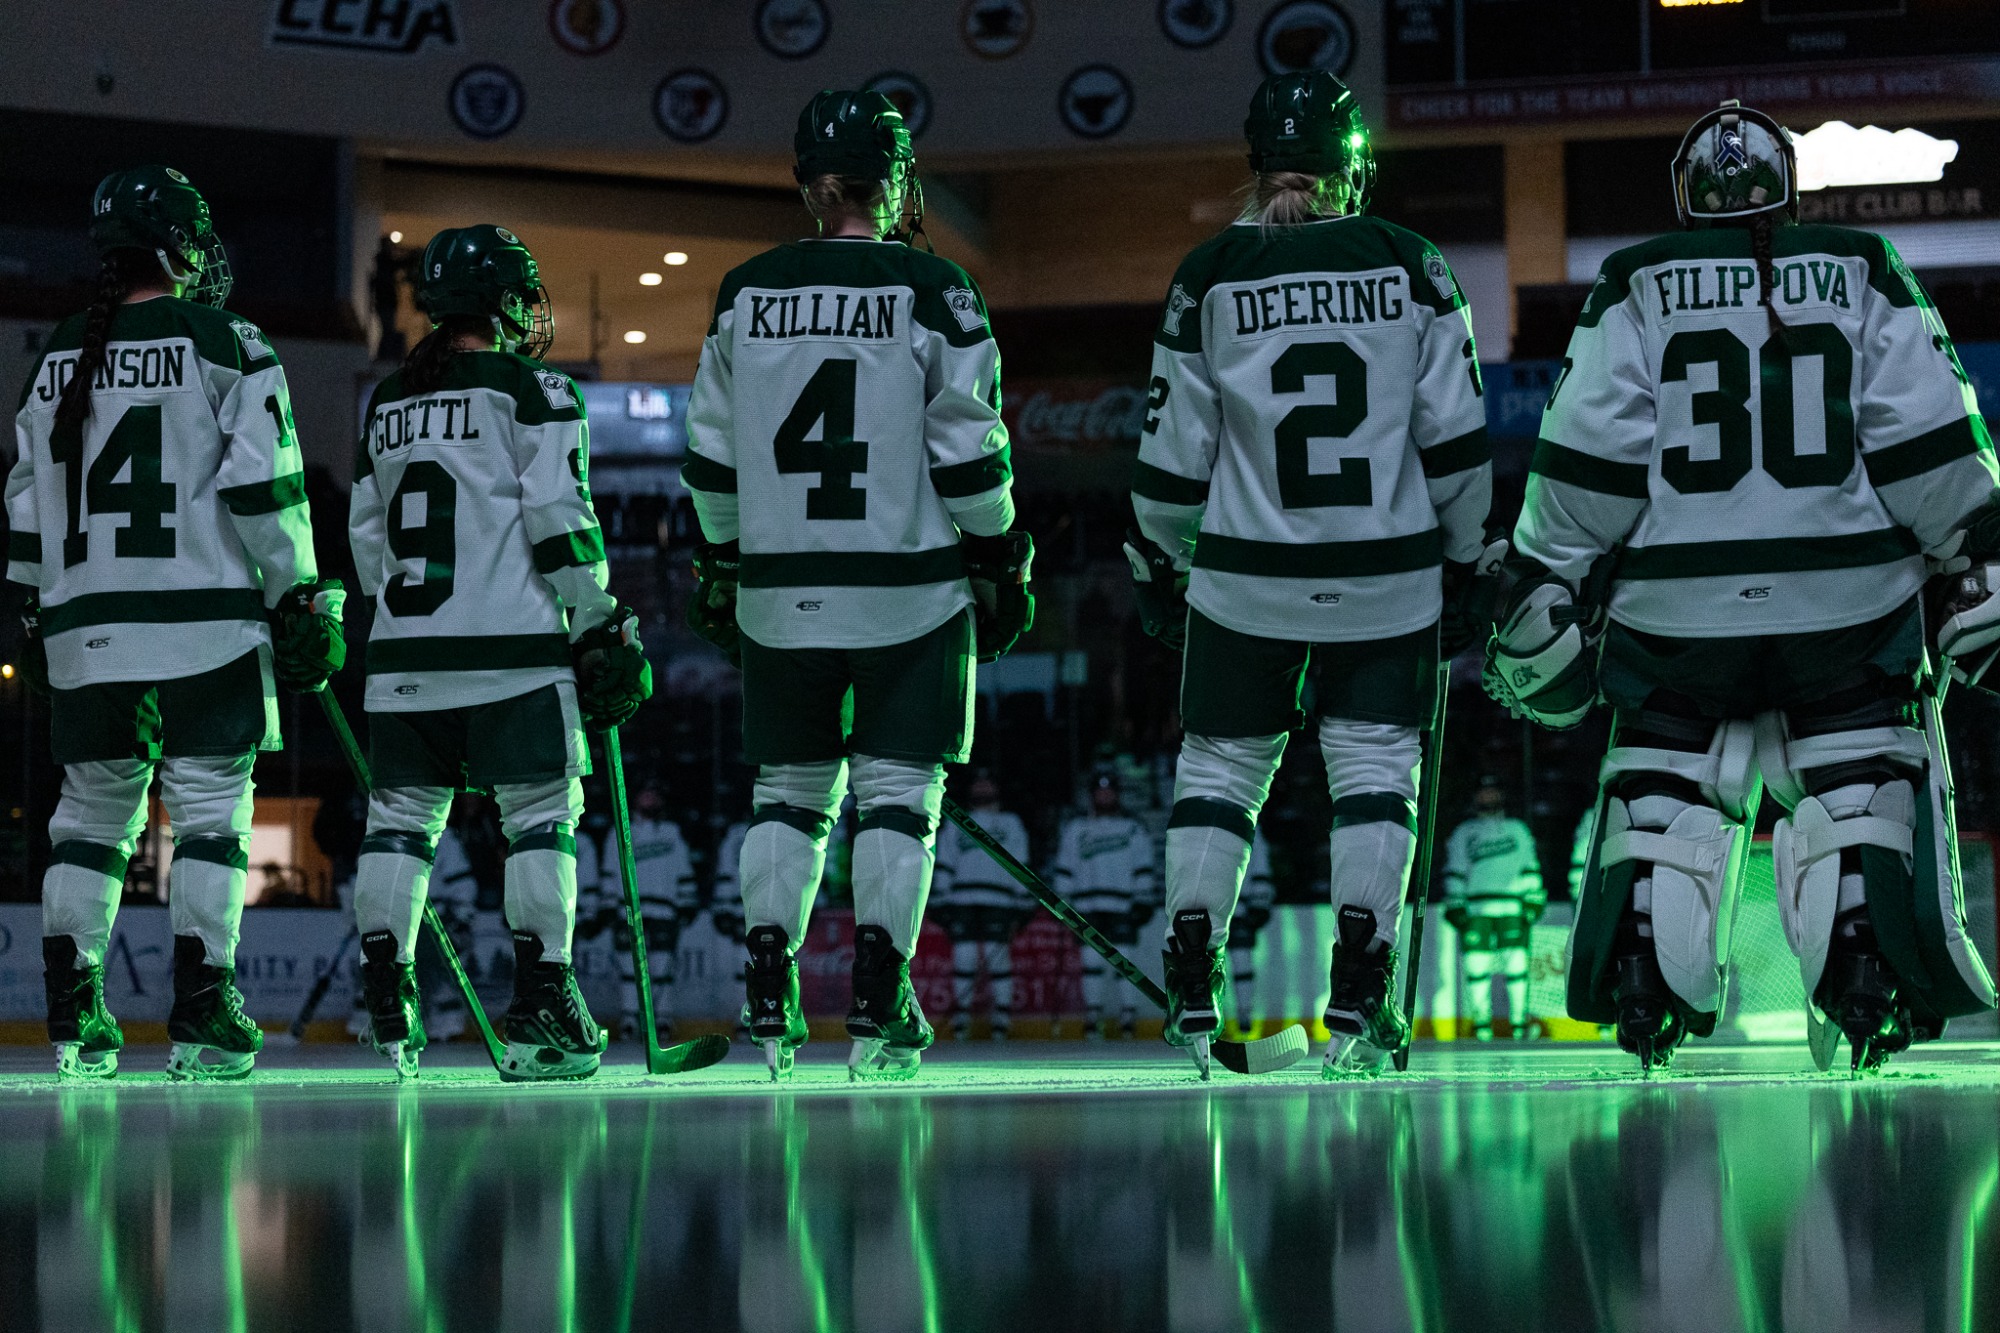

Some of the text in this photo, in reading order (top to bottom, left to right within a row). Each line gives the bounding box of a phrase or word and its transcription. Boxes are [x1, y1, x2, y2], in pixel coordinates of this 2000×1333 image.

[825, 122, 835, 137] 4
[1284, 118, 1295, 134] 2
[100, 198, 111, 213] 14
[434, 263, 442, 278] 9
[1654, 261, 1850, 317] FILIPPOVA
[748, 294, 895, 339] KILLIAN
[1233, 275, 1403, 336] DEERING
[37, 345, 185, 402] JONSON
[375, 398, 479, 455] GOETTL
[1143, 376, 1170, 435] 2
[1271, 342, 1373, 507] 2
[1660, 323, 1854, 493] 30
[773, 359, 869, 520] 4
[49, 404, 176, 570] 14
[384, 460, 456, 618] 9
[796, 600, 823, 612] EPS
[1310, 593, 1342, 605] EPS
[1739, 586, 1772, 598] EPS
[85, 637, 111, 650] EPS
[394, 684, 420, 696] EPS
[1180, 913, 1205, 922] CCM
[1343, 909, 1369, 920] CCM
[366, 933, 389, 943] CCM
[1054, 900, 1145, 985] CCM
[537, 1008, 580, 1051] CCM
